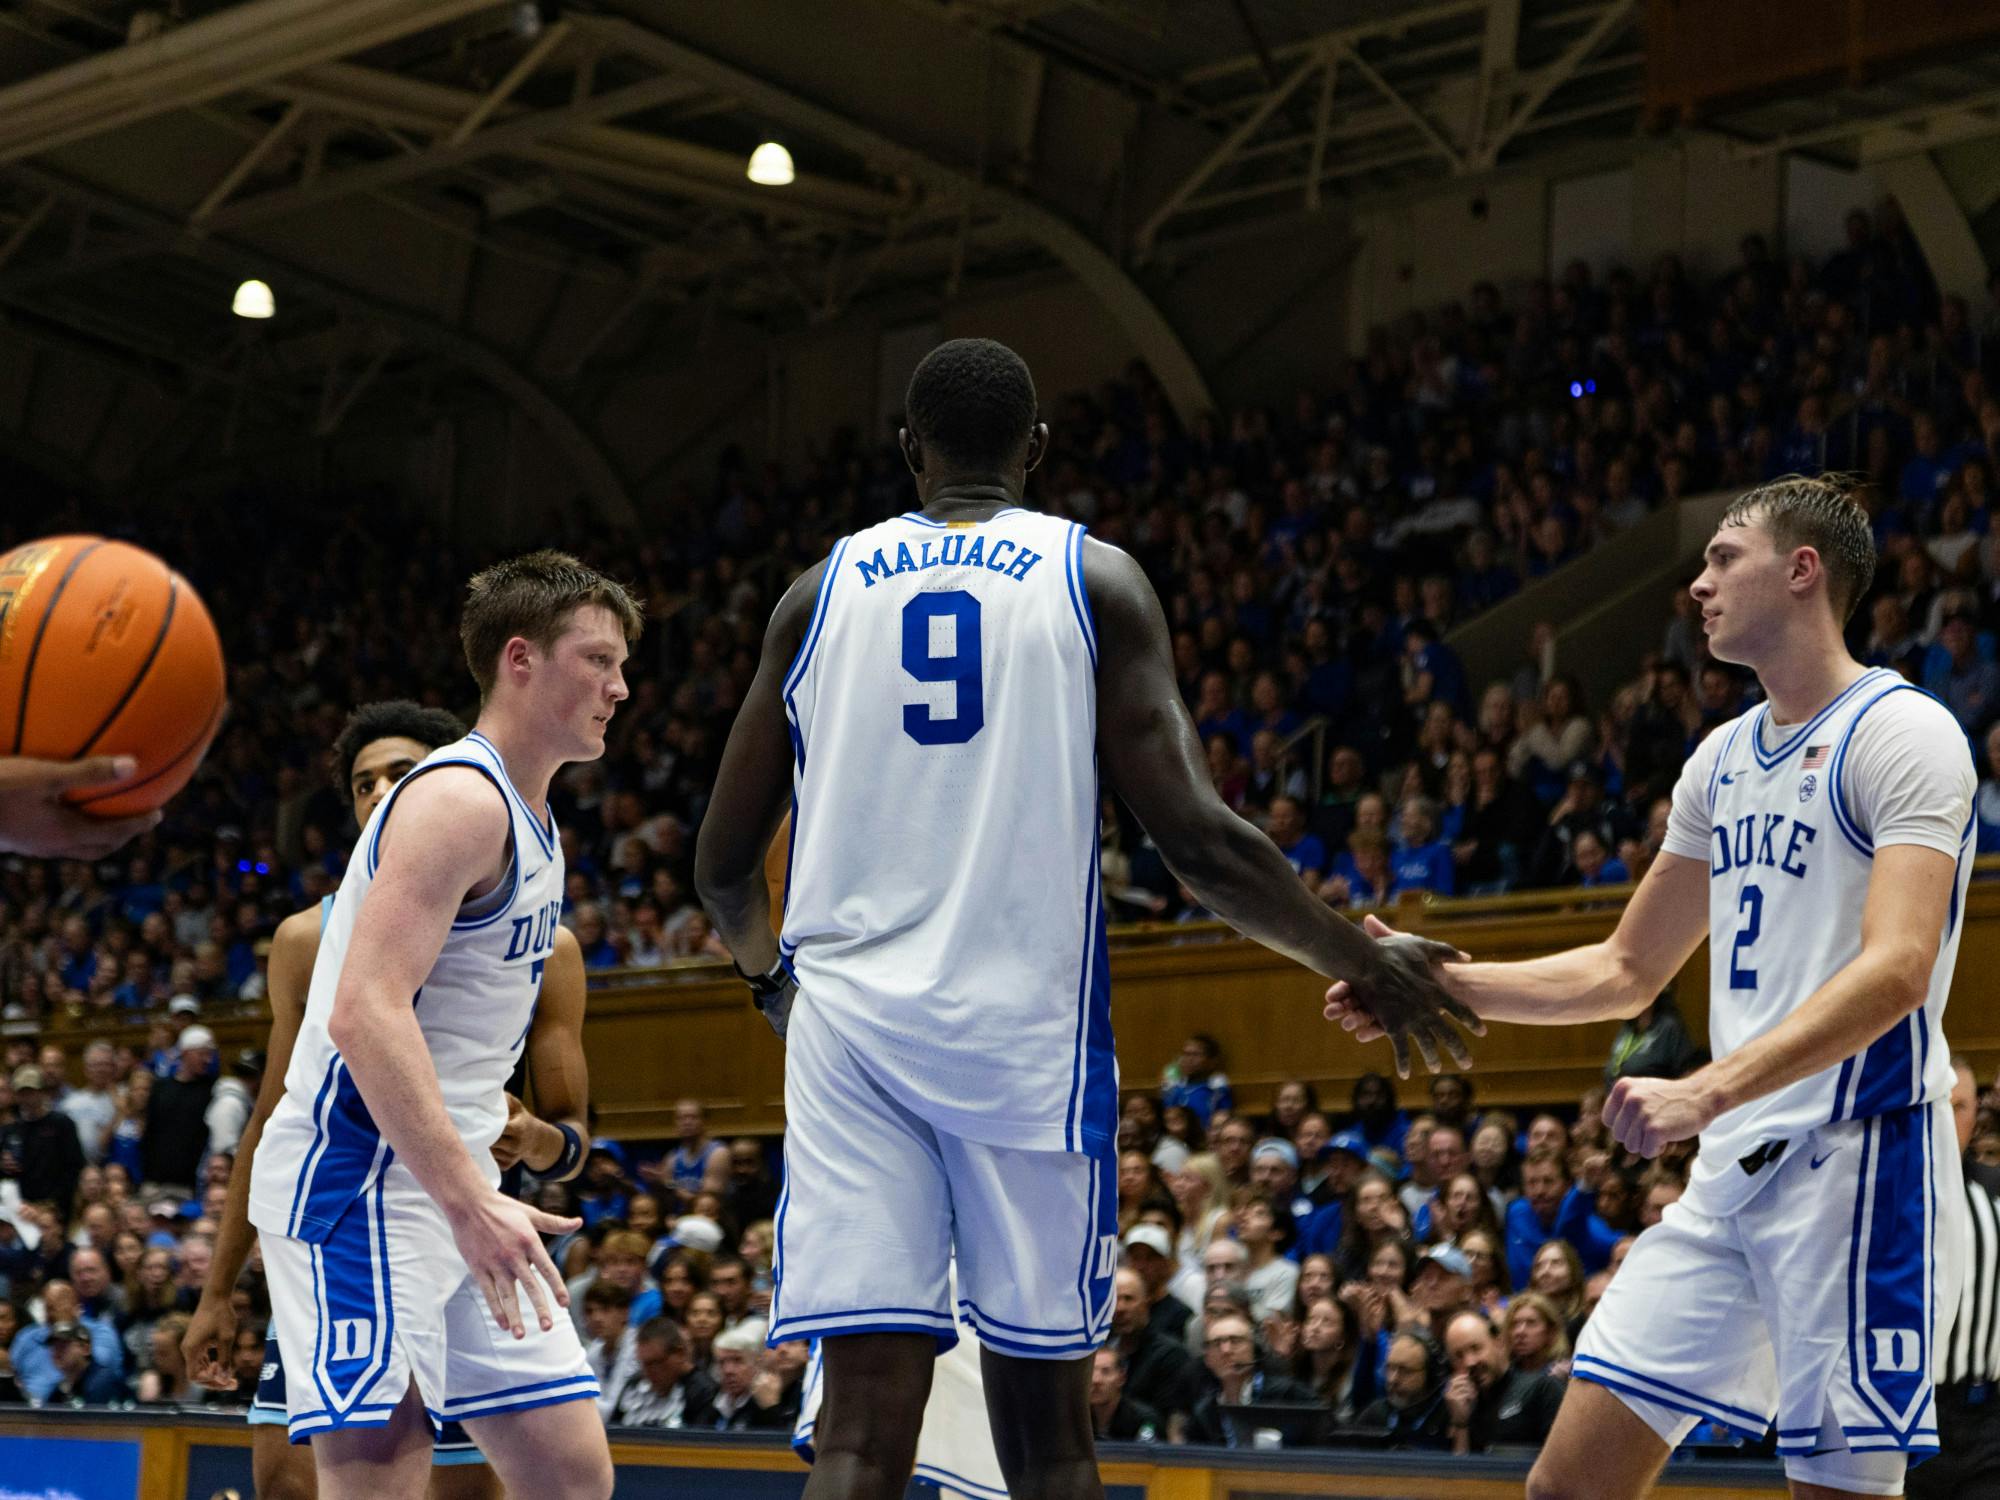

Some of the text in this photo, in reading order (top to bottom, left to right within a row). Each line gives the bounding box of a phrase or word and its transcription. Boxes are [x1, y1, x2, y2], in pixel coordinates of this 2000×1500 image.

[855, 534, 1042, 588] MALUACH
[901, 589, 985, 746] 9
[1711, 813, 1817, 879] DUKE
[1730, 884, 1764, 990] 2
[330, 1317, 372, 1362] D
[1869, 1327, 1921, 1373] D
